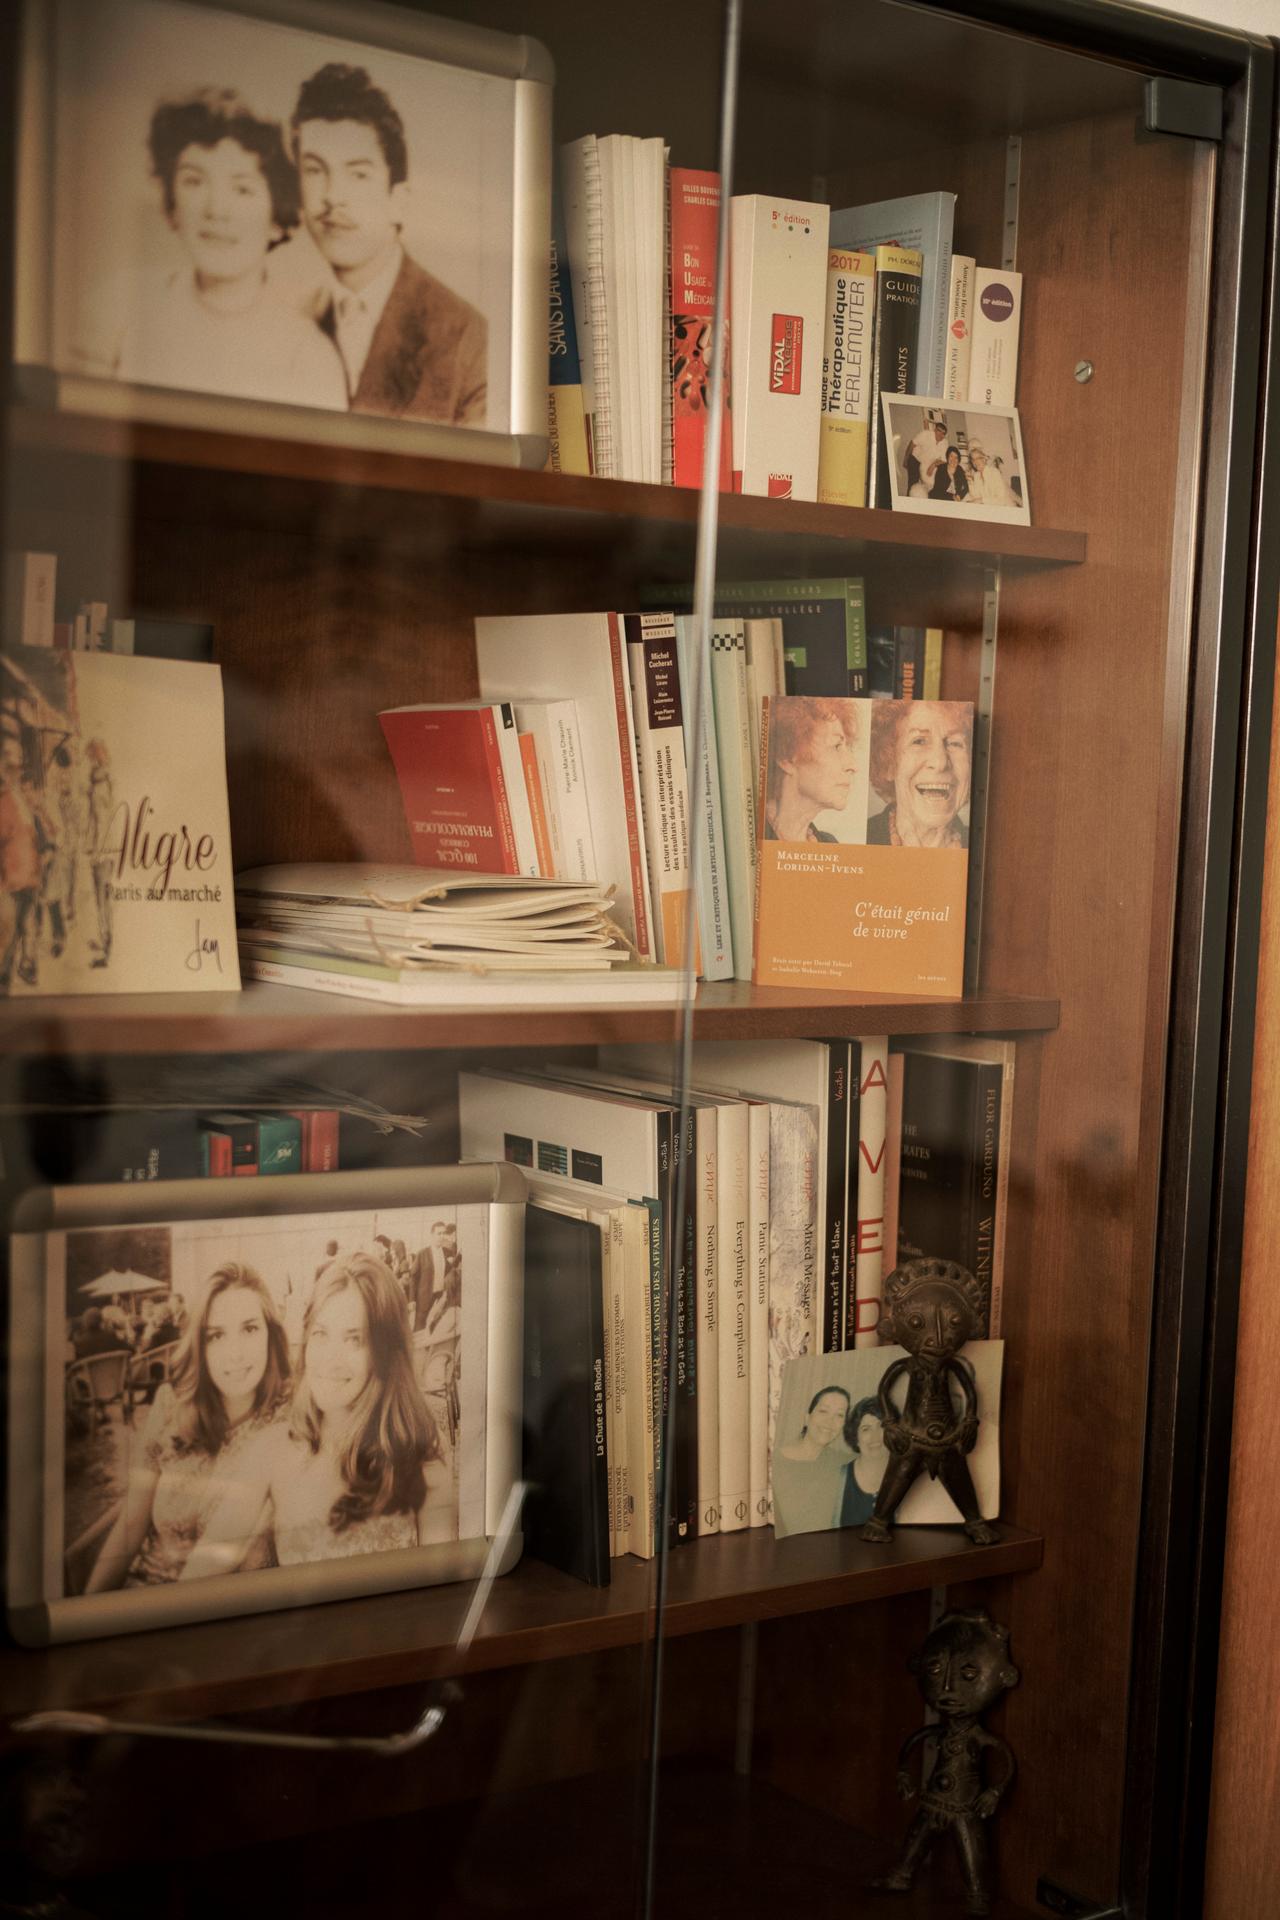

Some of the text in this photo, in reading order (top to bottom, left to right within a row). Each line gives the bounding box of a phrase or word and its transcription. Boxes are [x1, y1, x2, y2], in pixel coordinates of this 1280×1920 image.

[784, 212, 811, 226] édition
[684, 253, 699, 268] BON
[831, 254, 861, 272] 2017
[684, 272, 707, 287] USAGE
[885, 280, 921, 295] GUIDE
[549, 310, 567, 355] SANS
[827, 278, 847, 412] Thérapeutique
[844, 281, 865, 416] PERLEMUTER
[651, 652, 669, 660] Michel
[656, 750, 666, 802] interprétation
[664, 745, 680, 871] des résultats des essais cliniques
[677, 790, 686, 818] médicale
[660, 813, 670, 842] critique
[98, 796, 218, 900] Aligre
[663, 844, 671, 872] Lecture
[708, 845, 717, 873] ARTICLE
[777, 851, 840, 862] MARCELINE
[710, 875, 718, 885] UN
[776, 862, 864, 875] LORIDAN-IVENS
[147, 889, 163, 901] au
[168, 884, 222, 902] marché
[711, 886, 721, 923] CRITIQUER
[855, 901, 950, 926] C'était génial
[714, 924, 722, 933] ET
[715, 934, 724, 949] LIRE
[853, 922, 908, 940] de vivre
[835, 1067, 843, 1102] Voutch
[985, 1088, 996, 1124] FLOR
[660, 1140, 668, 1172] Voutch
[651, 1218, 660, 1269] AFFAIRES
[758, 1222, 768, 1253] Panic
[803, 1223, 814, 1261] Mixed
[831, 1220, 841, 1249] blanc
[704, 1225, 715, 1275] Nothing
[733, 1221, 745, 1288] Everything
[831, 1252, 840, 1276] tout
[652, 1271, 660, 1290] DES
[677, 1265, 686, 1284] This
[707, 1279, 715, 1288] is
[757, 1256, 768, 1305] Stations
[736, 1291, 744, 1301] is
[800, 1264, 813, 1320] Messages
[830, 1280, 839, 1306] n'est
[653, 1290, 661, 1332] MONDE
[677, 1314, 685, 1334] Bad
[706, 1291, 715, 1333] Simple
[653, 1335, 661, 1348] LE
[678, 1337, 685, 1349] as
[734, 1303, 745, 1379] Complicated
[677, 1360, 686, 1385] Gets
[652, 1357, 662, 1418] YORKER
[594, 1358, 604, 1457] La Chute de la Rhodia
